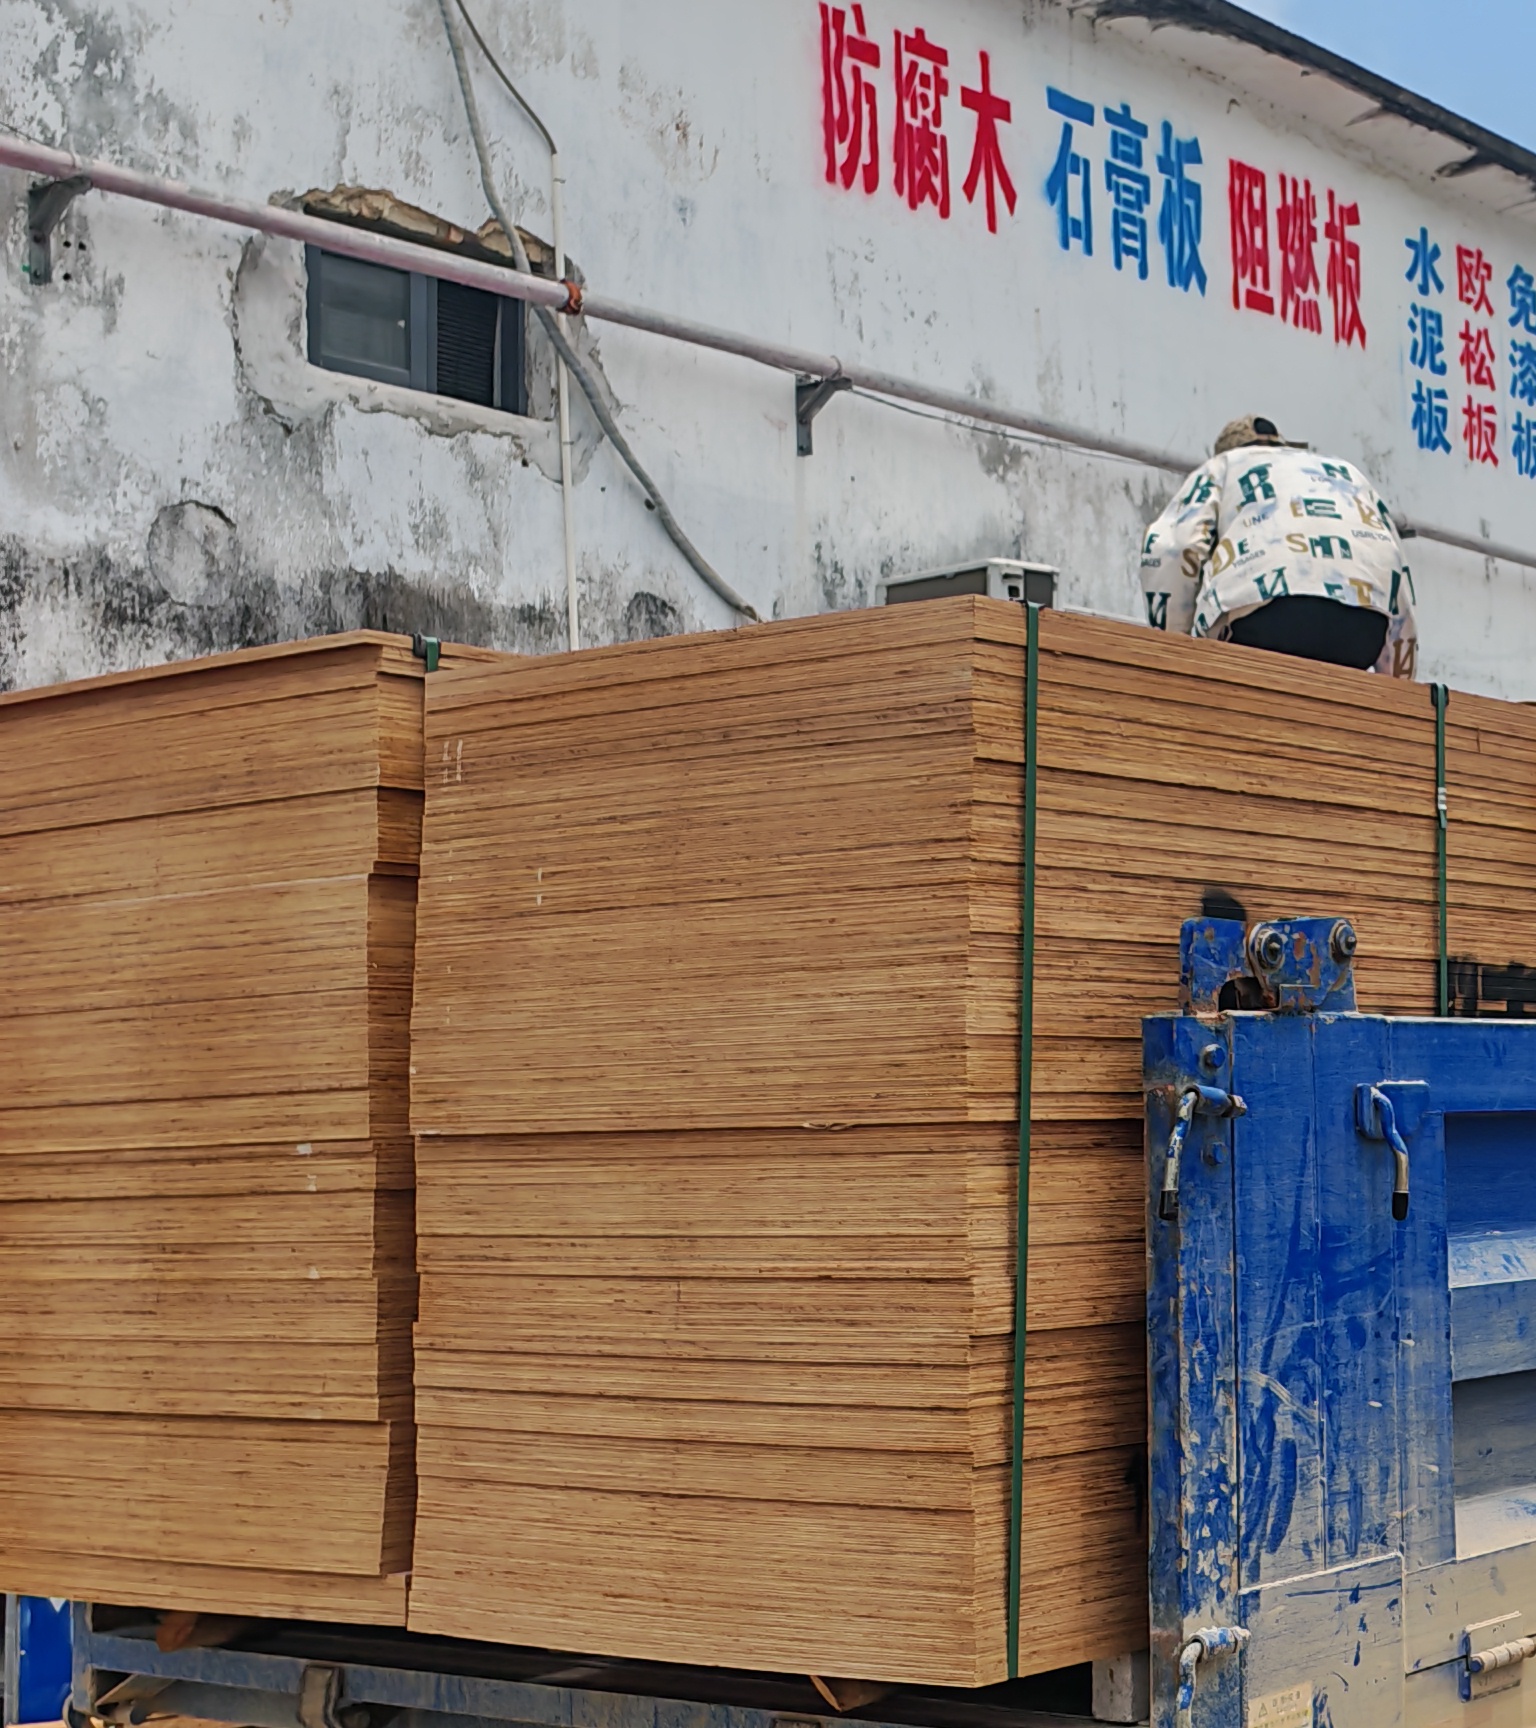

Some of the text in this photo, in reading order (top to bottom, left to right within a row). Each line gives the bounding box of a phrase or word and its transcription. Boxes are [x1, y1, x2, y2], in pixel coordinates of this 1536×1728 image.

[820, 2, 1366, 349] 防腐木 石膏板 阻燃板
[1405, 226, 1452, 454] 水泥板
[1456, 244, 1499, 468] 欧松板
